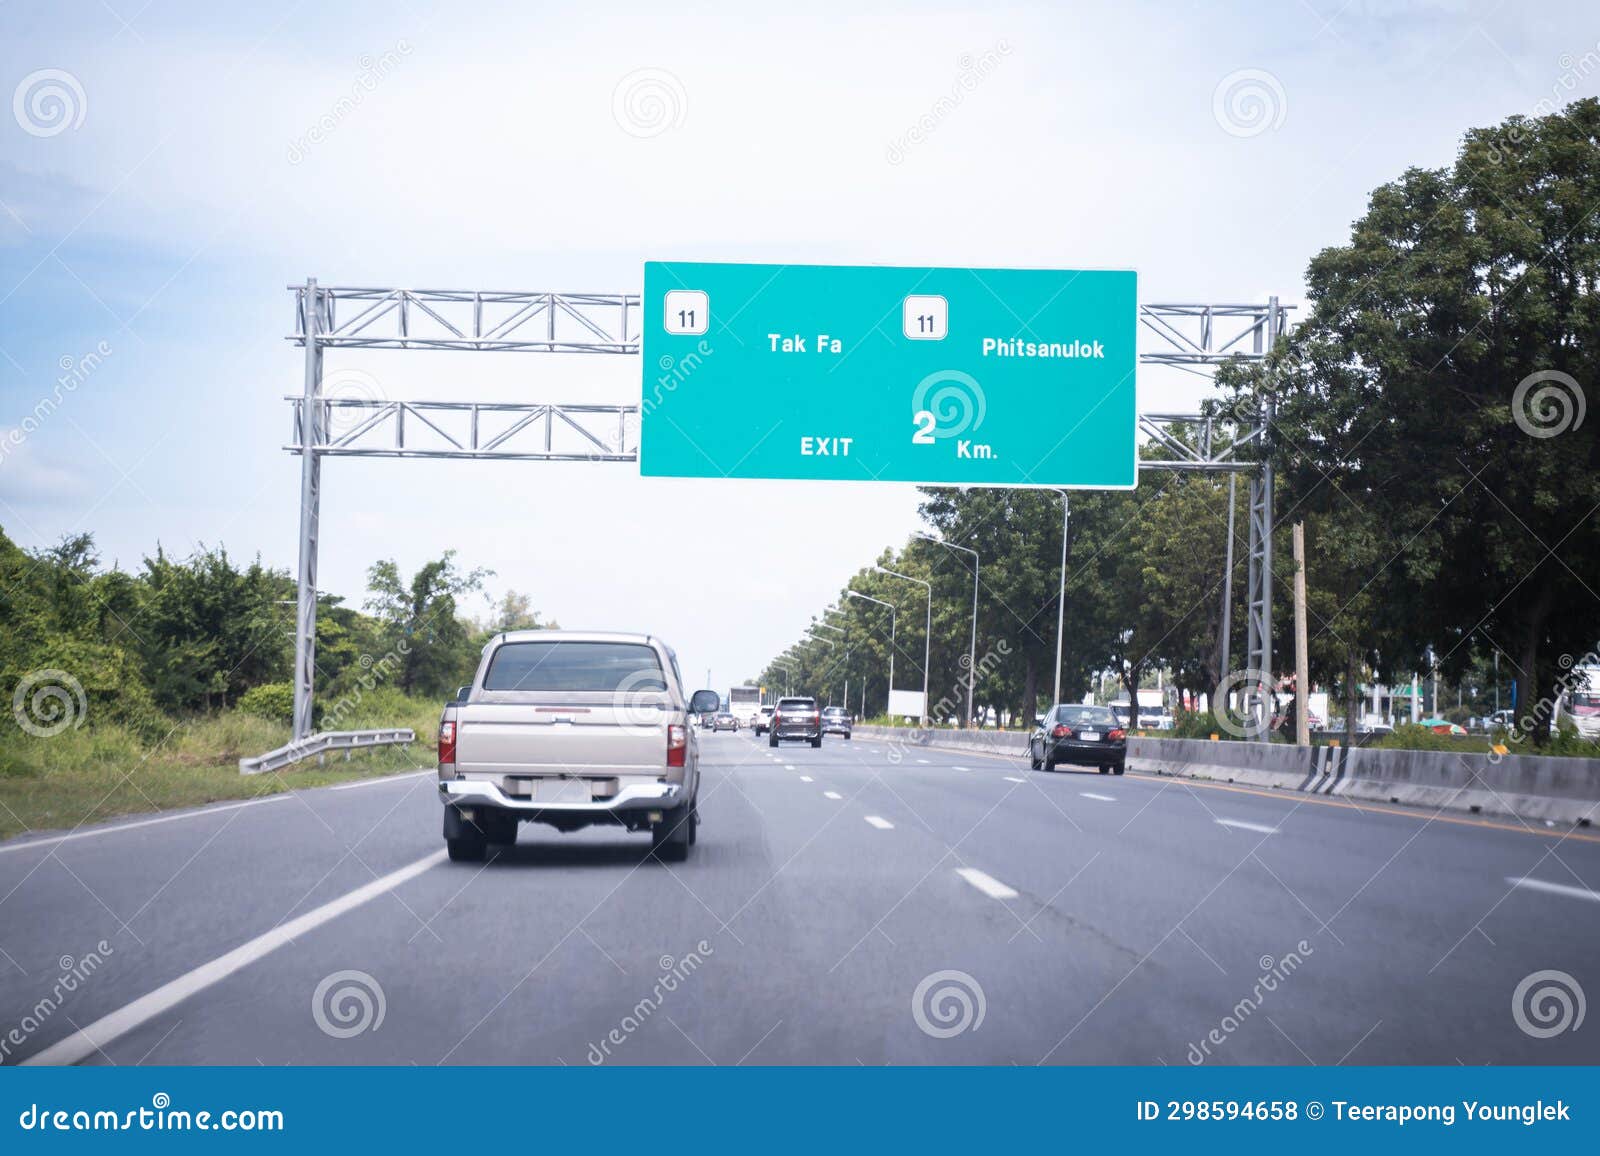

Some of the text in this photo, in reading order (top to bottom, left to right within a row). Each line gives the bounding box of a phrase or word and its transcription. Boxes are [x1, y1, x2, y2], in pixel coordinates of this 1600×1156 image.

[678, 311, 695, 328] 11
[917, 315, 934, 333] 11
[767, 333, 842, 353] Tak Fa
[983, 338, 1105, 358] Phitsanulok
[801, 410, 997, 459] EXIT 2 Km.
